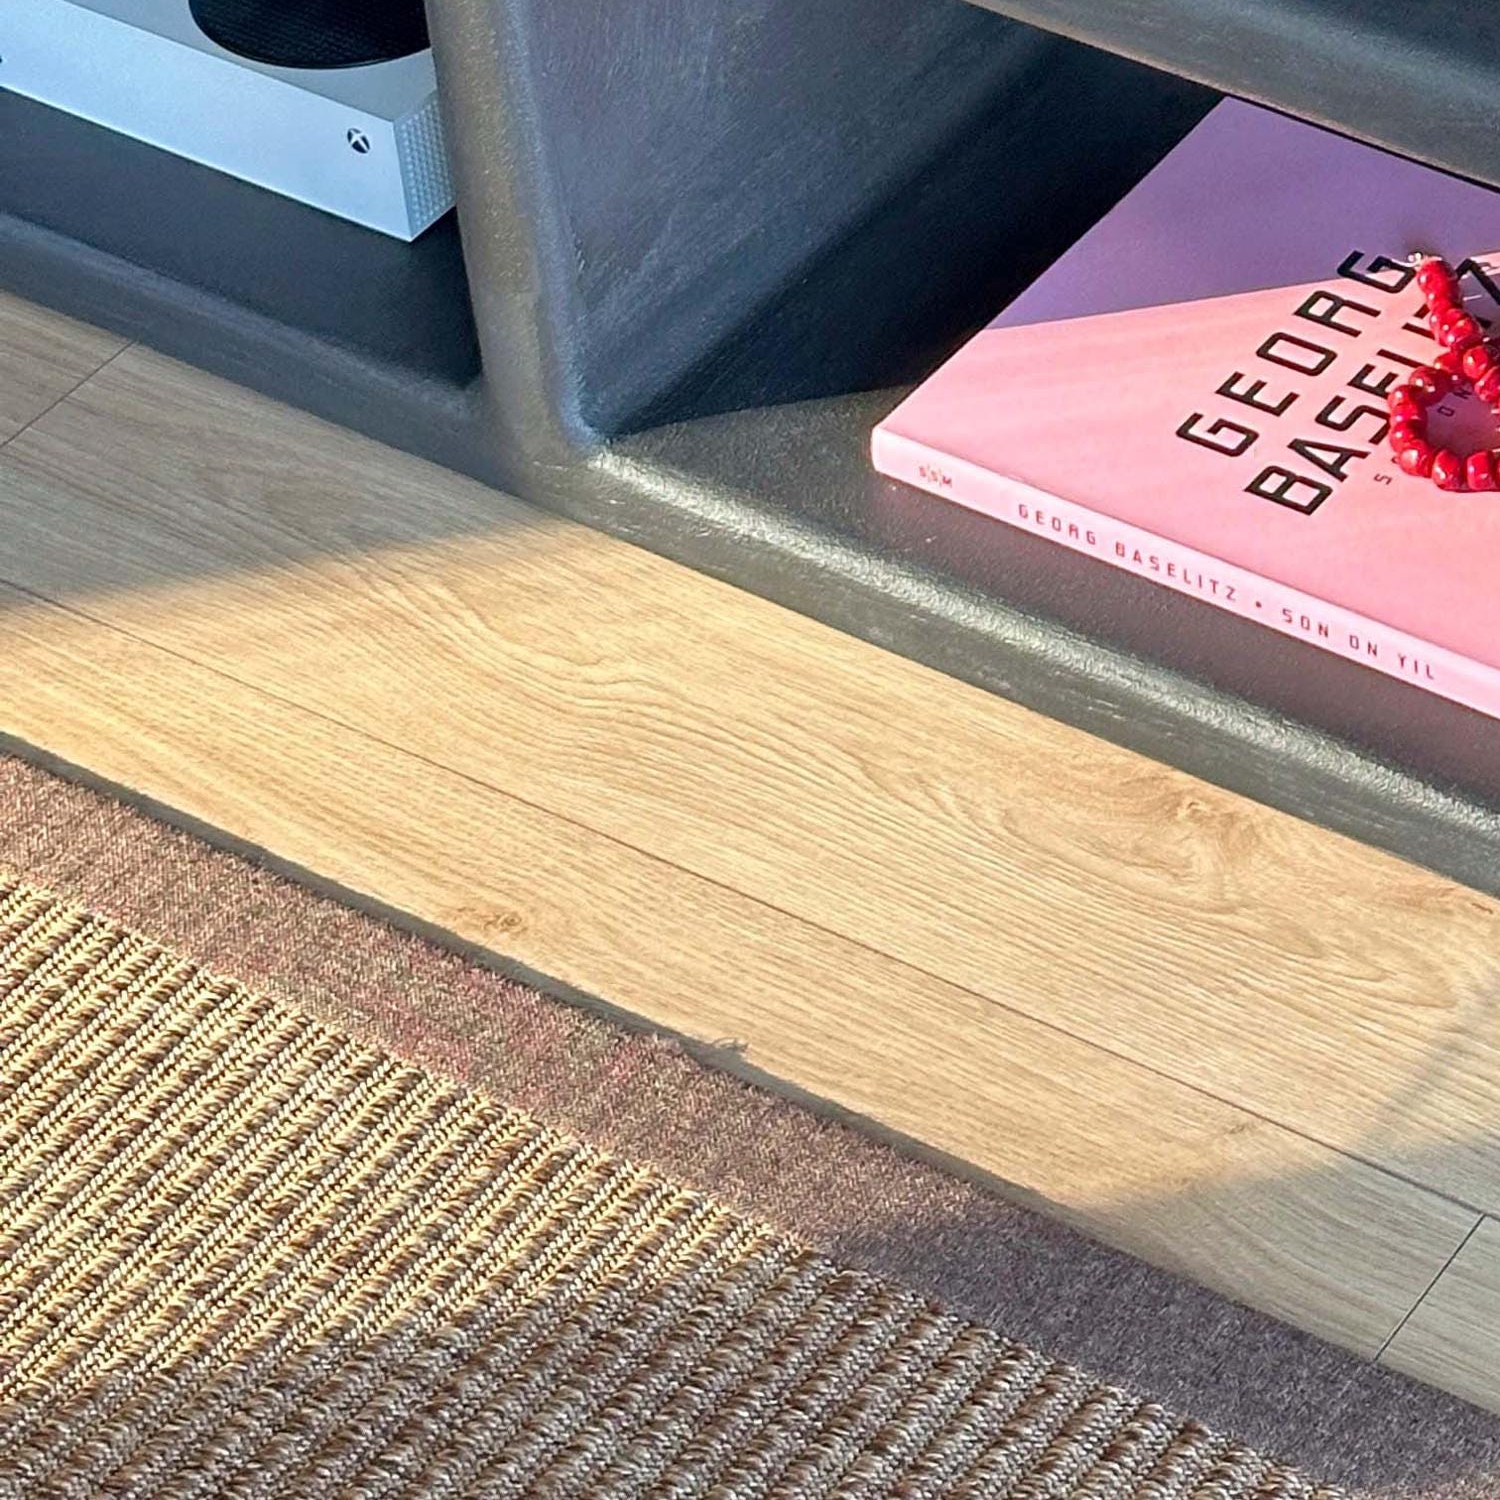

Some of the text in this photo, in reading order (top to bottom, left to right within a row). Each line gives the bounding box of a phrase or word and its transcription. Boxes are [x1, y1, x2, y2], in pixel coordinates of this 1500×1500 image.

[1175, 250, 1417, 458] GEORG
[1018, 503, 1434, 680] GEORG BASELITZ SON ON YIL
